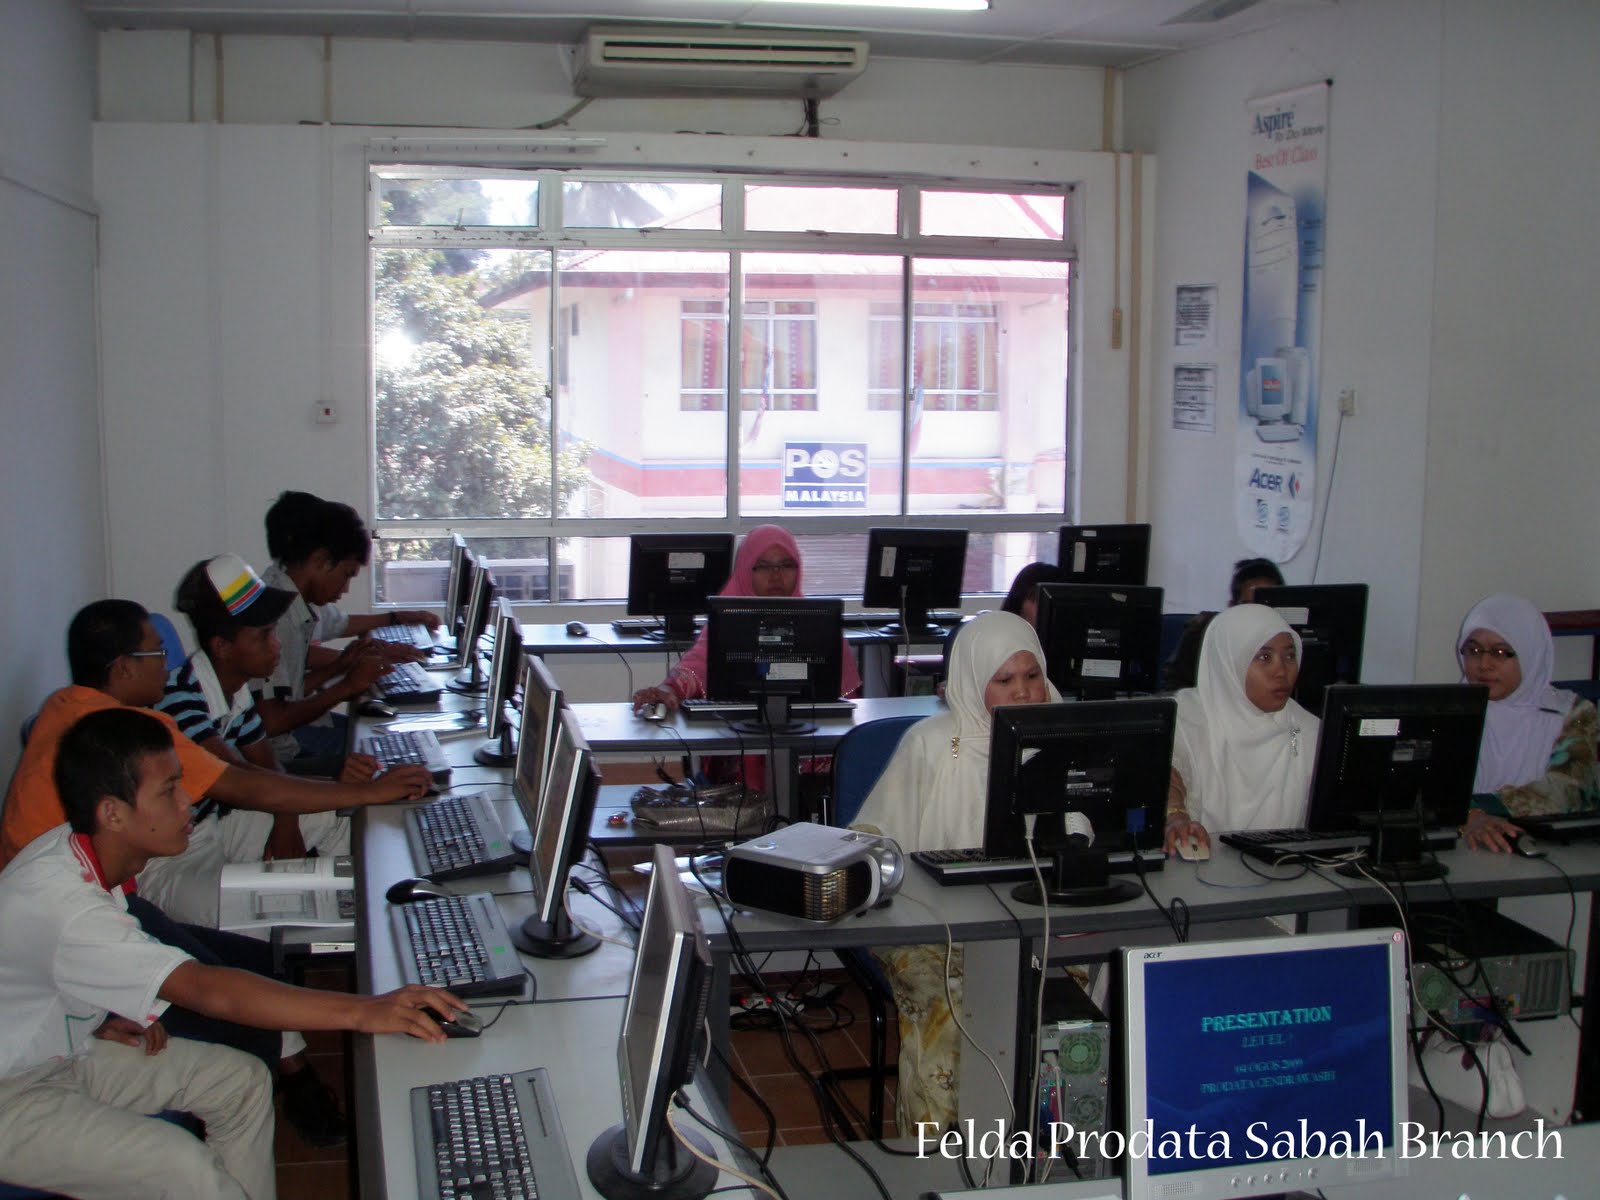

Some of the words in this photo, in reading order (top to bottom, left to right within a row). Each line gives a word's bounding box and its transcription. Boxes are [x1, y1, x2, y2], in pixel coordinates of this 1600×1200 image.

[1252, 107, 1296, 139] Aspire
[1255, 153, 1273, 170] Best
[785, 448, 866, 479] POS
[785, 490, 865, 502] MALAYSIA
[1201, 1005, 1332, 1033] PRESENTATION
[1200, 1079, 1255, 1094] PRODATA
